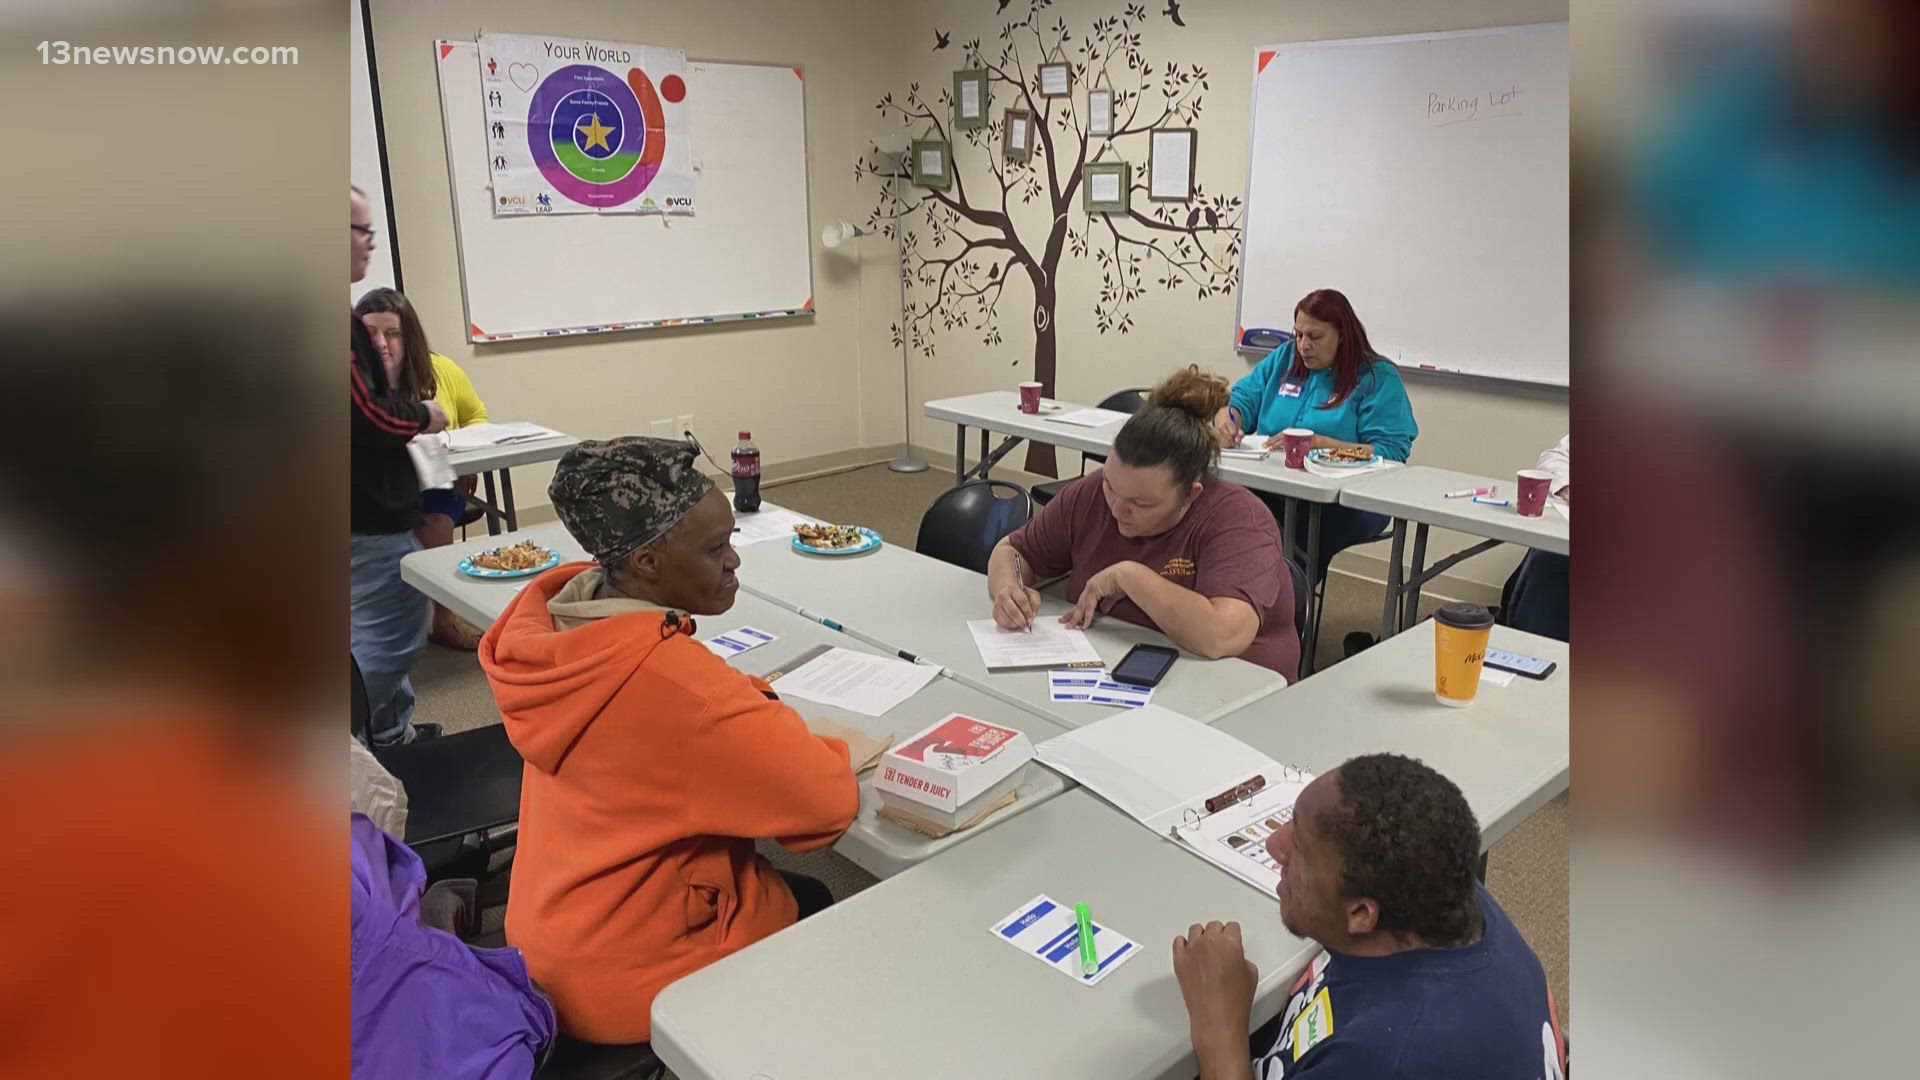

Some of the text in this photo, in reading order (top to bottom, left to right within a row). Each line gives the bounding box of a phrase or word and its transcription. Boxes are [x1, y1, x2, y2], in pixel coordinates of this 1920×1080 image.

[1427, 85, 1524, 120] Parking Lot
[507, 197, 526, 205] VCU
[673, 197, 692, 206] VCU
[896, 772, 924, 790] TENDER
[923, 782, 930, 792] &
[929, 783, 952, 800] JUICY
[1019, 912, 1037, 926] Hello
